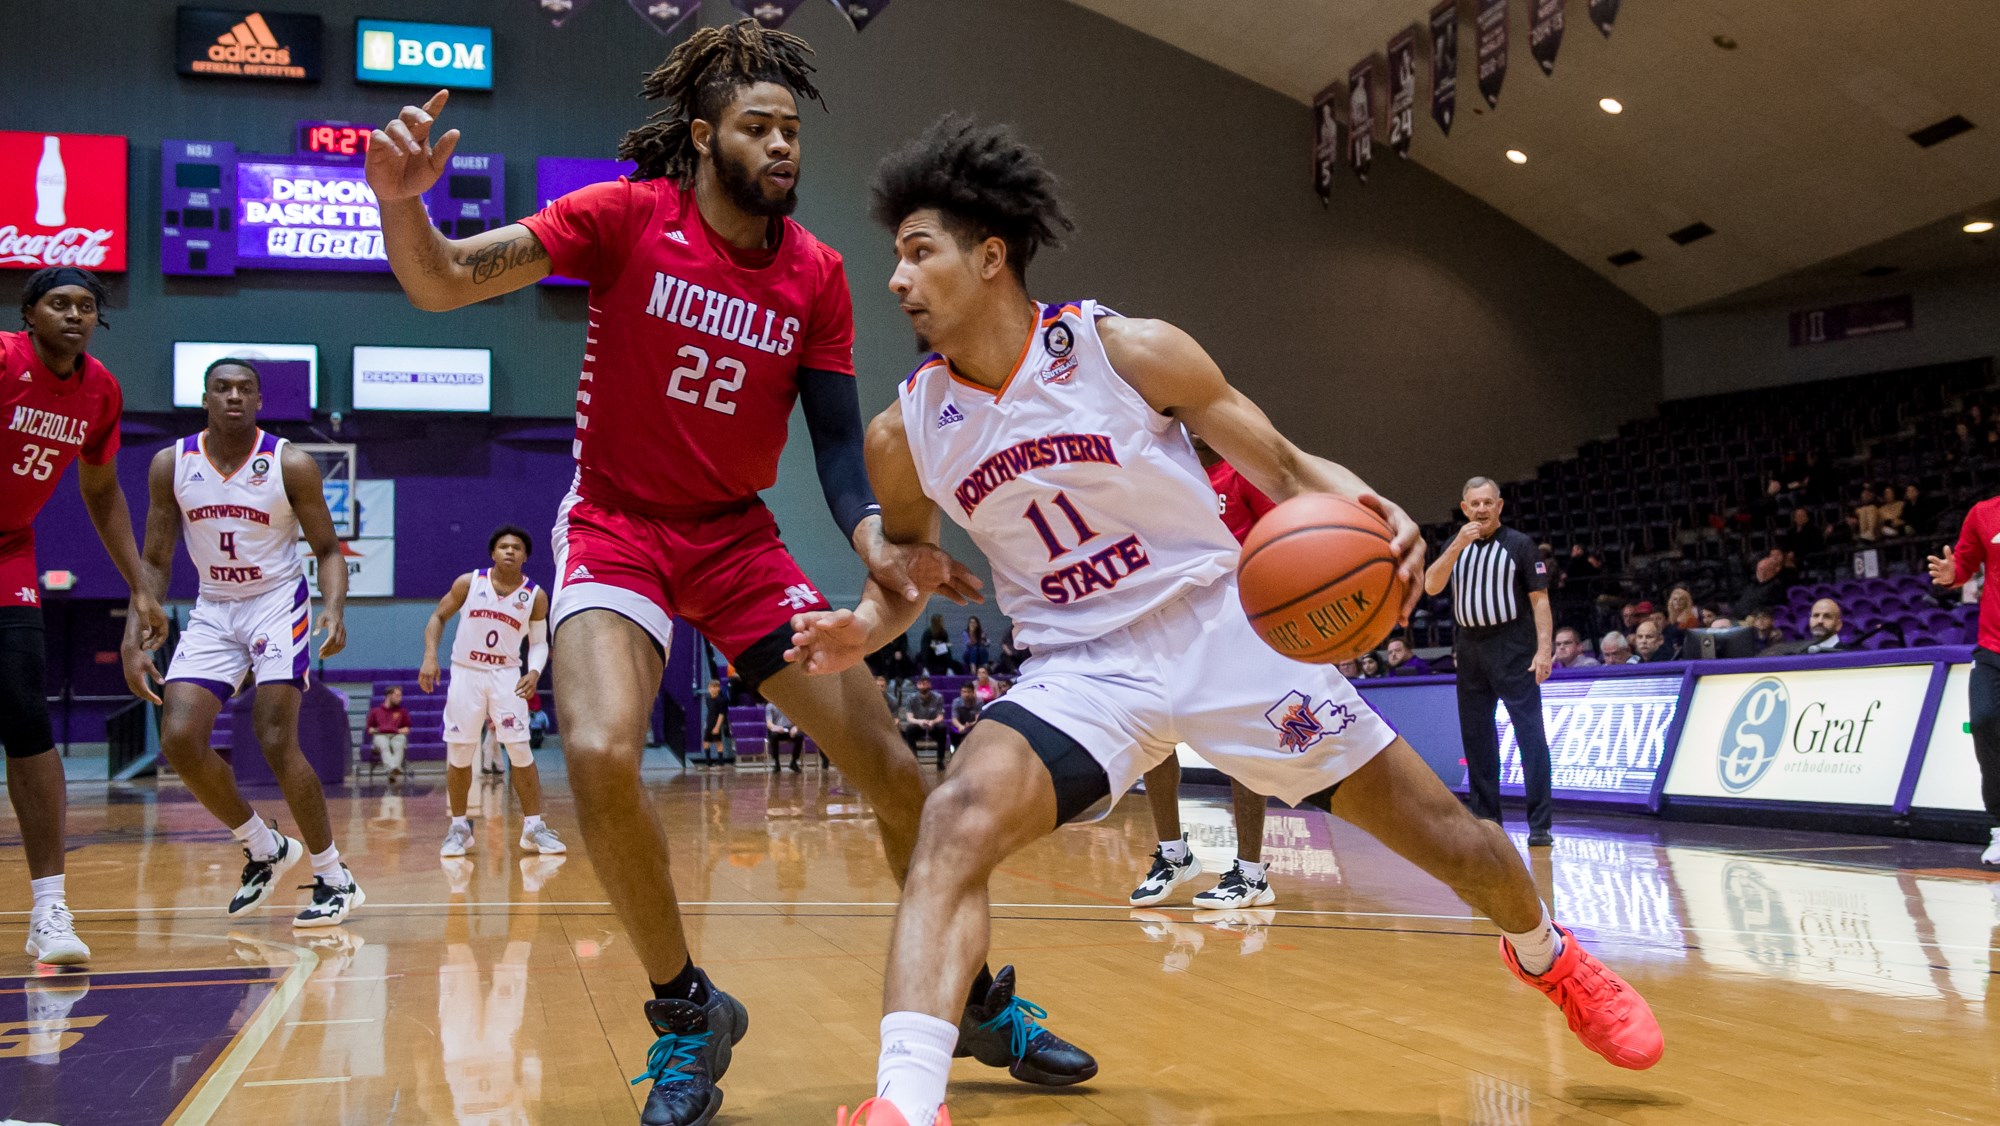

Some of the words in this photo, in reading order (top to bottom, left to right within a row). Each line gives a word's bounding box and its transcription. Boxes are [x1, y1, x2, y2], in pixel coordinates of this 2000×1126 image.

[208, 41, 291, 65] adidas
[398, 39, 485, 70] BOM
[1391, 109, 1412, 144] 24
[187, 144, 212, 158] NSU
[310, 127, 371, 155] 19:27
[452, 156, 490, 170] GUEST
[273, 178, 377, 204] DEMON
[247, 202, 381, 227] BASKETB
[272, 232, 386, 256] #IGetT
[645, 271, 800, 356] NICHOLLS
[362, 370, 409, 383] DEMON
[417, 371, 483, 385] REWARDS
[665, 344, 747, 415] 22
[9, 405, 88, 445] NICHOLLS
[937, 413, 964, 429] adidas
[12, 443, 60, 481] 35
[954, 433, 1123, 521] NORTHWESTERN
[186, 504, 270, 526] NORTHWESTERN
[1022, 490, 1101, 563] 11
[219, 531, 238, 560] 4
[210, 566, 262, 583] STATE
[1040, 533, 1150, 604] STATE
[1305, 589, 1371, 639] ROCK
[486, 629, 499, 648] 0
[469, 651, 507, 665] STATE
[1793, 699, 1881, 754] Graf
[1784, 761, 1862, 774] orthodontics
